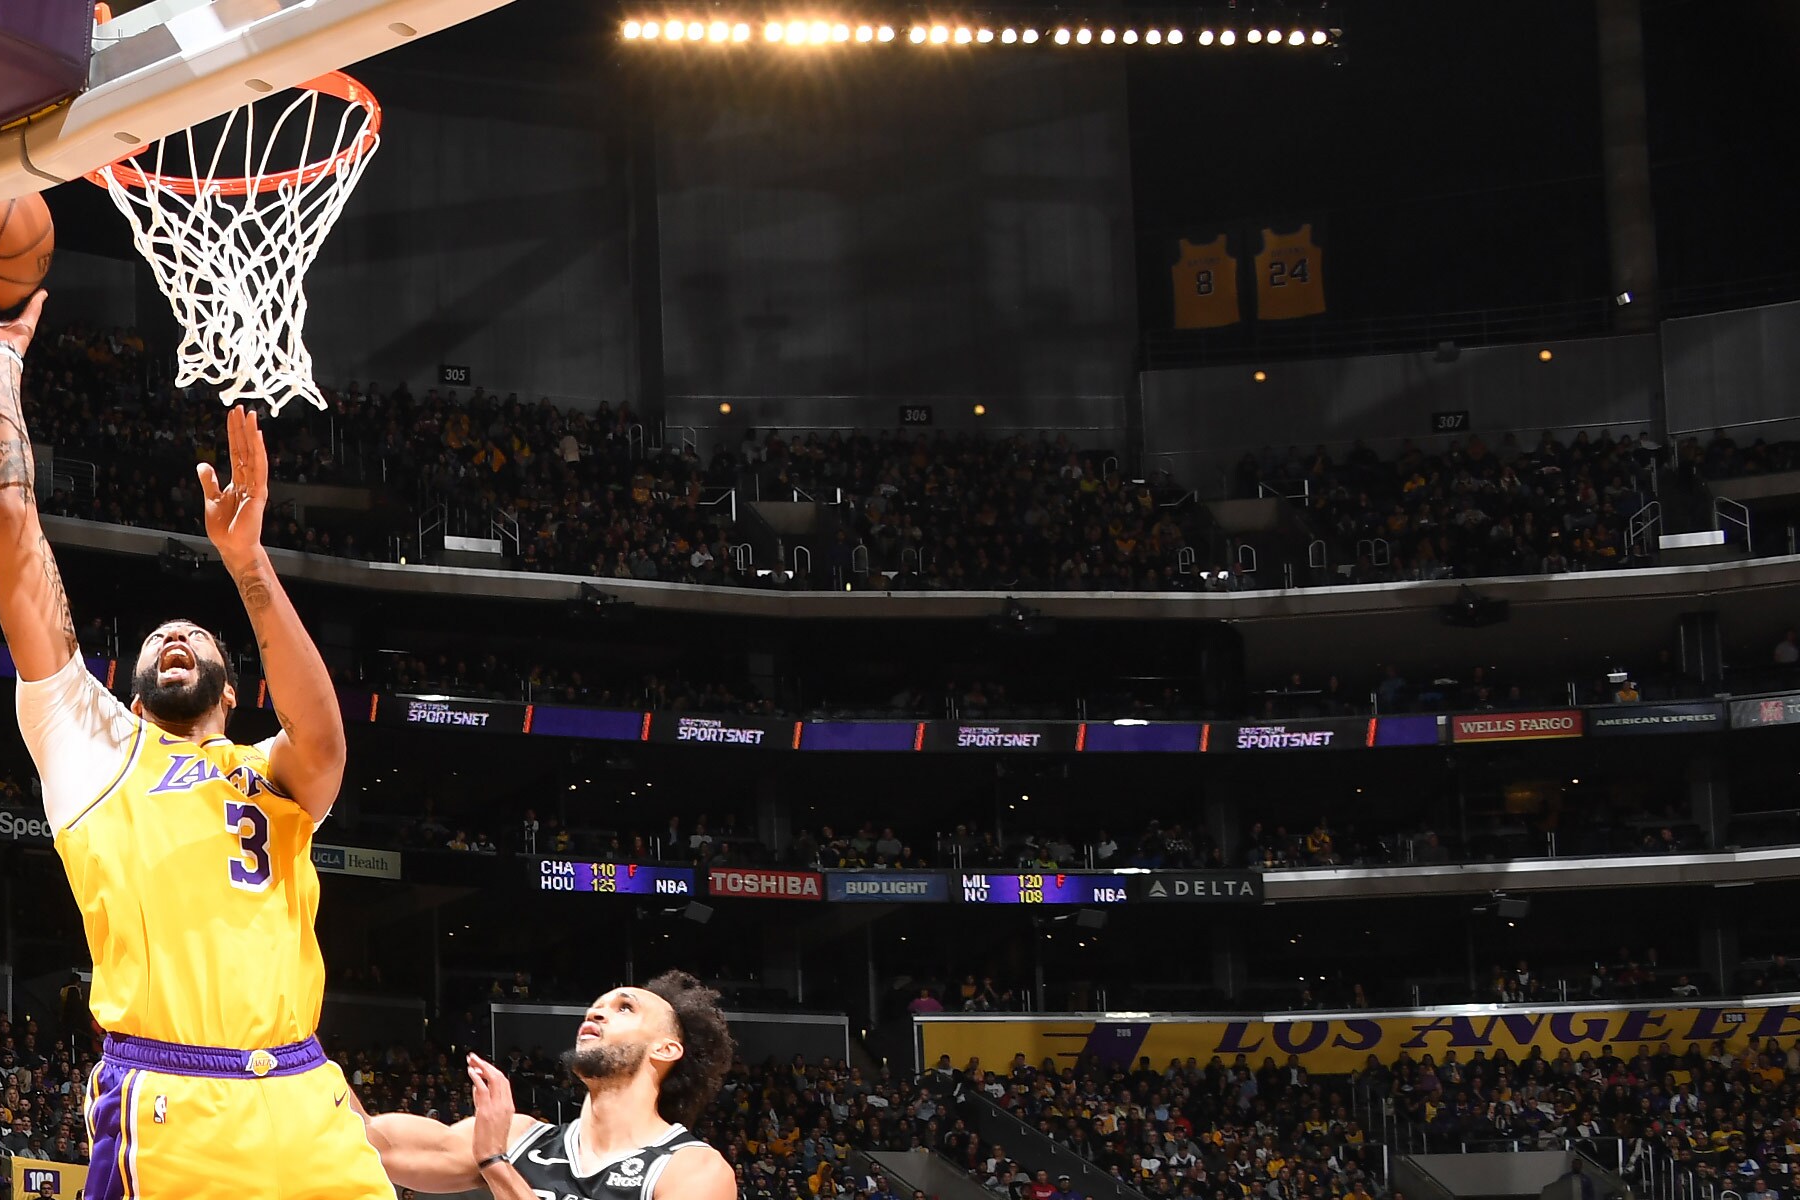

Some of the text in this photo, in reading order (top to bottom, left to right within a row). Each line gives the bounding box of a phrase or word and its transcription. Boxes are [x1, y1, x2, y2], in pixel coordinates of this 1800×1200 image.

[1269, 257, 1310, 288] 24
[1196, 269, 1214, 296] 8
[445, 369, 466, 381] 305
[407, 709, 489, 727] SPORTSNET
[1460, 717, 1574, 734] WELLS FARGO
[1596, 713, 1717, 726] AMERICAN EXPRESS
[678, 727, 765, 744] SPORTSNET
[957, 734, 1041, 748] SPORTSNET
[1237, 731, 1334, 749] SPORTSNET
[225, 801, 272, 891] 3
[312, 852, 388, 871] UCLA Health
[540, 860, 638, 877] CHA 110 F
[541, 875, 688, 894] HOU 125 NBA
[711, 872, 819, 896] TOSHIBA
[845, 881, 928, 894] BUD LIGHT
[962, 874, 991, 888] MIL
[1056, 874, 1066, 888] F
[1174, 880, 1254, 896] DELTA
[964, 888, 988, 902] NO
[1093, 888, 1127, 902] NBA
[605, 1171, 645, 1188] Frost
